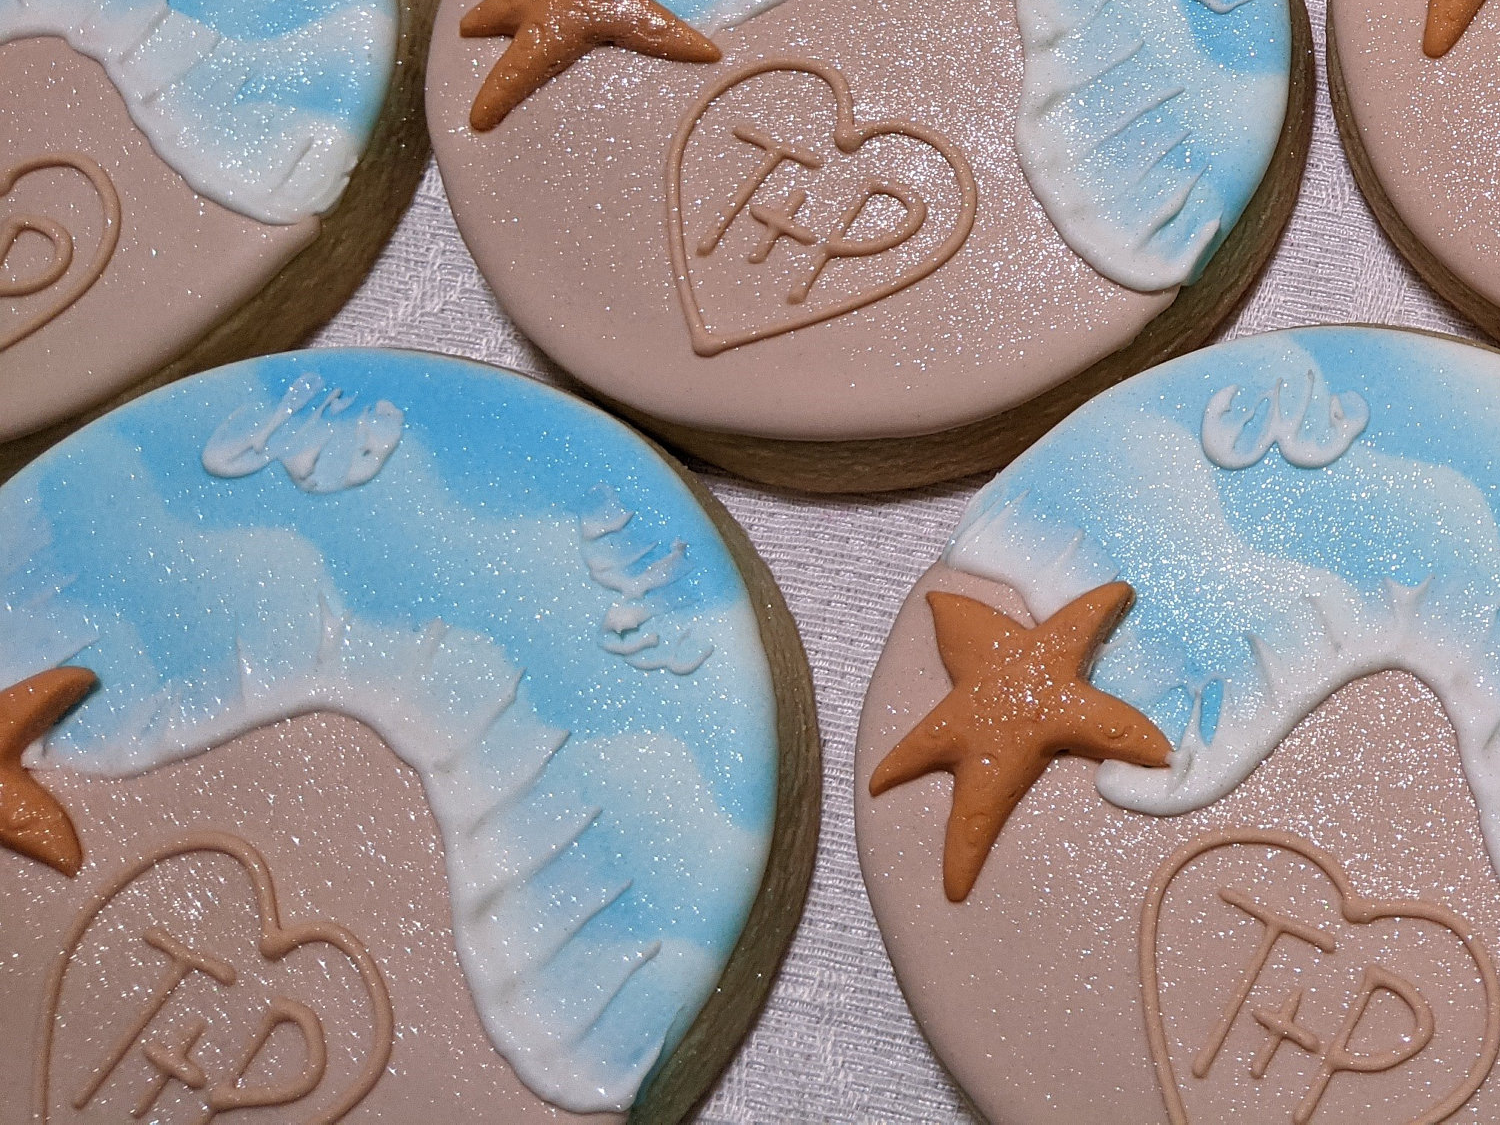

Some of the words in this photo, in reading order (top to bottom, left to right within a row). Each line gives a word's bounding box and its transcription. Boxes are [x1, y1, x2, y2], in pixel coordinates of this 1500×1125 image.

[696, 127, 927, 305] T+P
[72, 926, 327, 1125] T+P
[1192, 887, 1435, 1125] T+P
